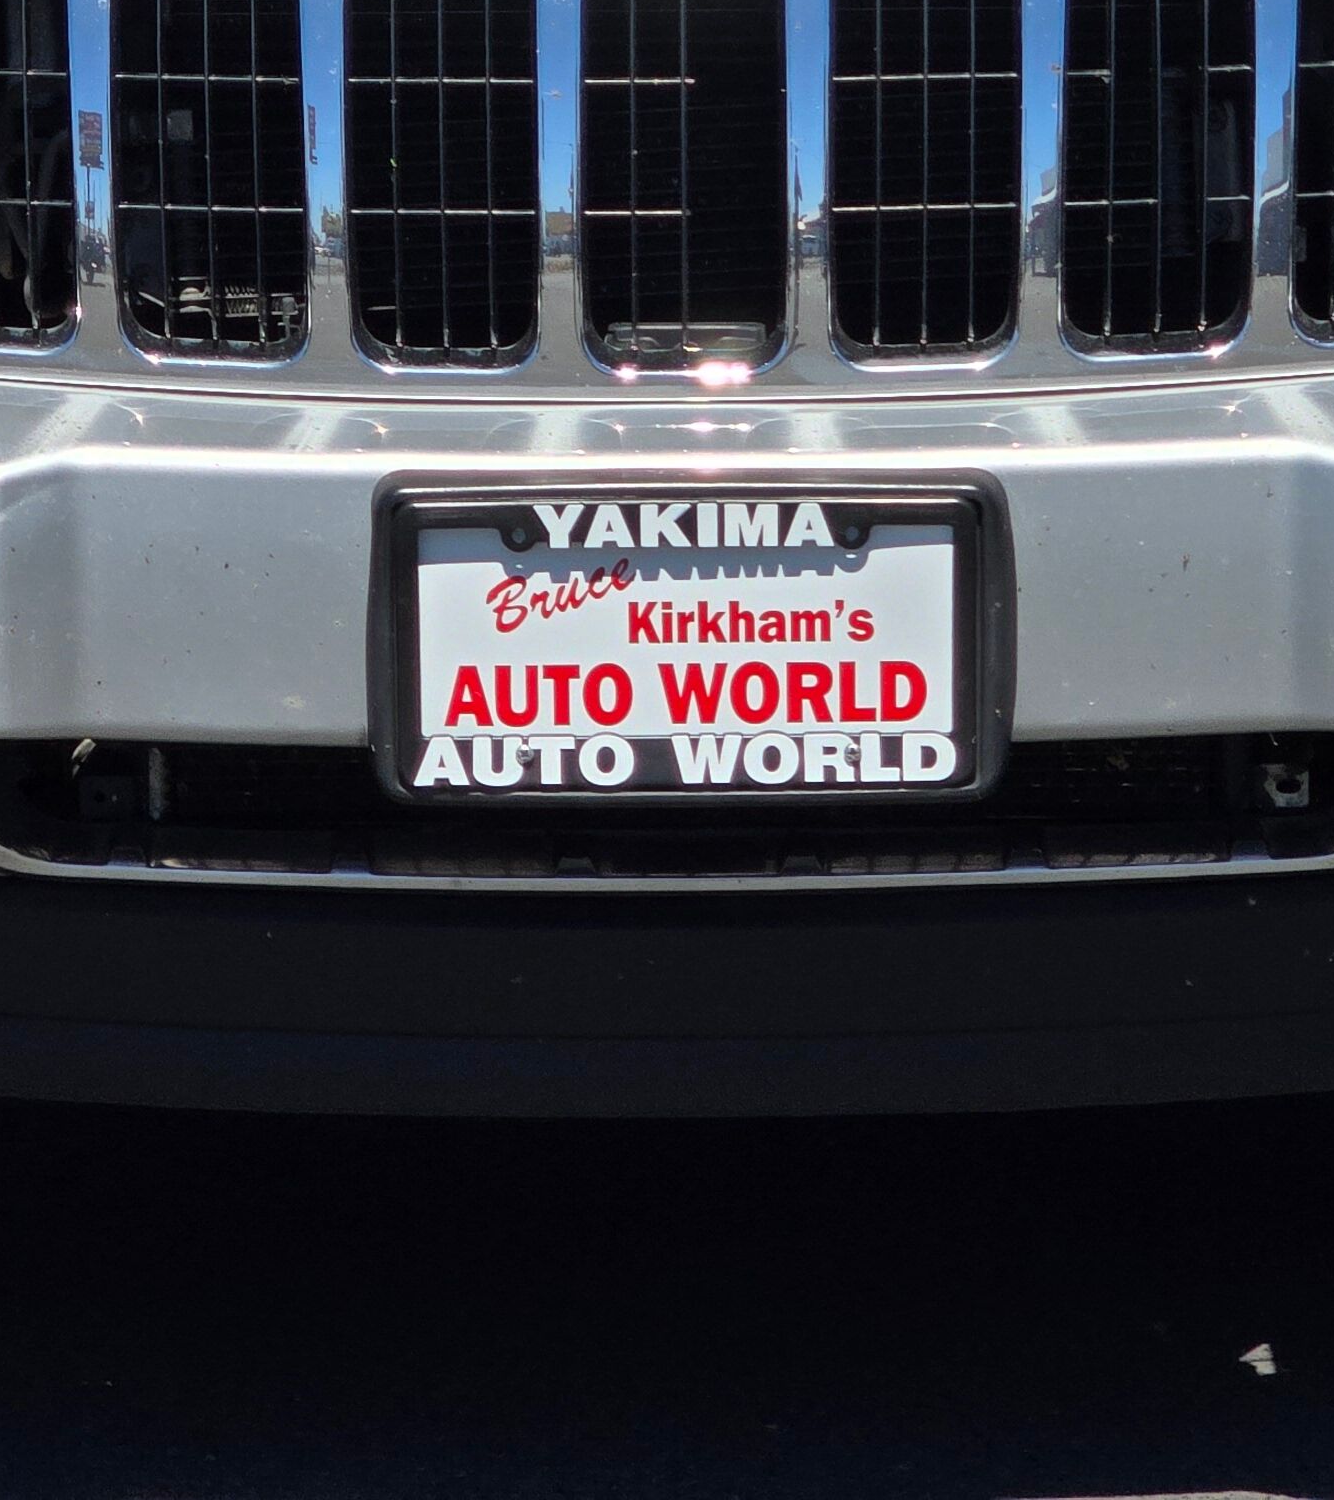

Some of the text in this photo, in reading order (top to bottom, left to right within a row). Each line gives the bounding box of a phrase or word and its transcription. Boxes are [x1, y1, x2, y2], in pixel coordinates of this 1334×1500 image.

[533, 502, 835, 549] YAKIMA
[485, 557, 636, 633] Bruce
[628, 600, 875, 644] Kirkham's
[444, 661, 928, 728] AUTO WORLD
[413, 731, 957, 787] AUTO WORLD
